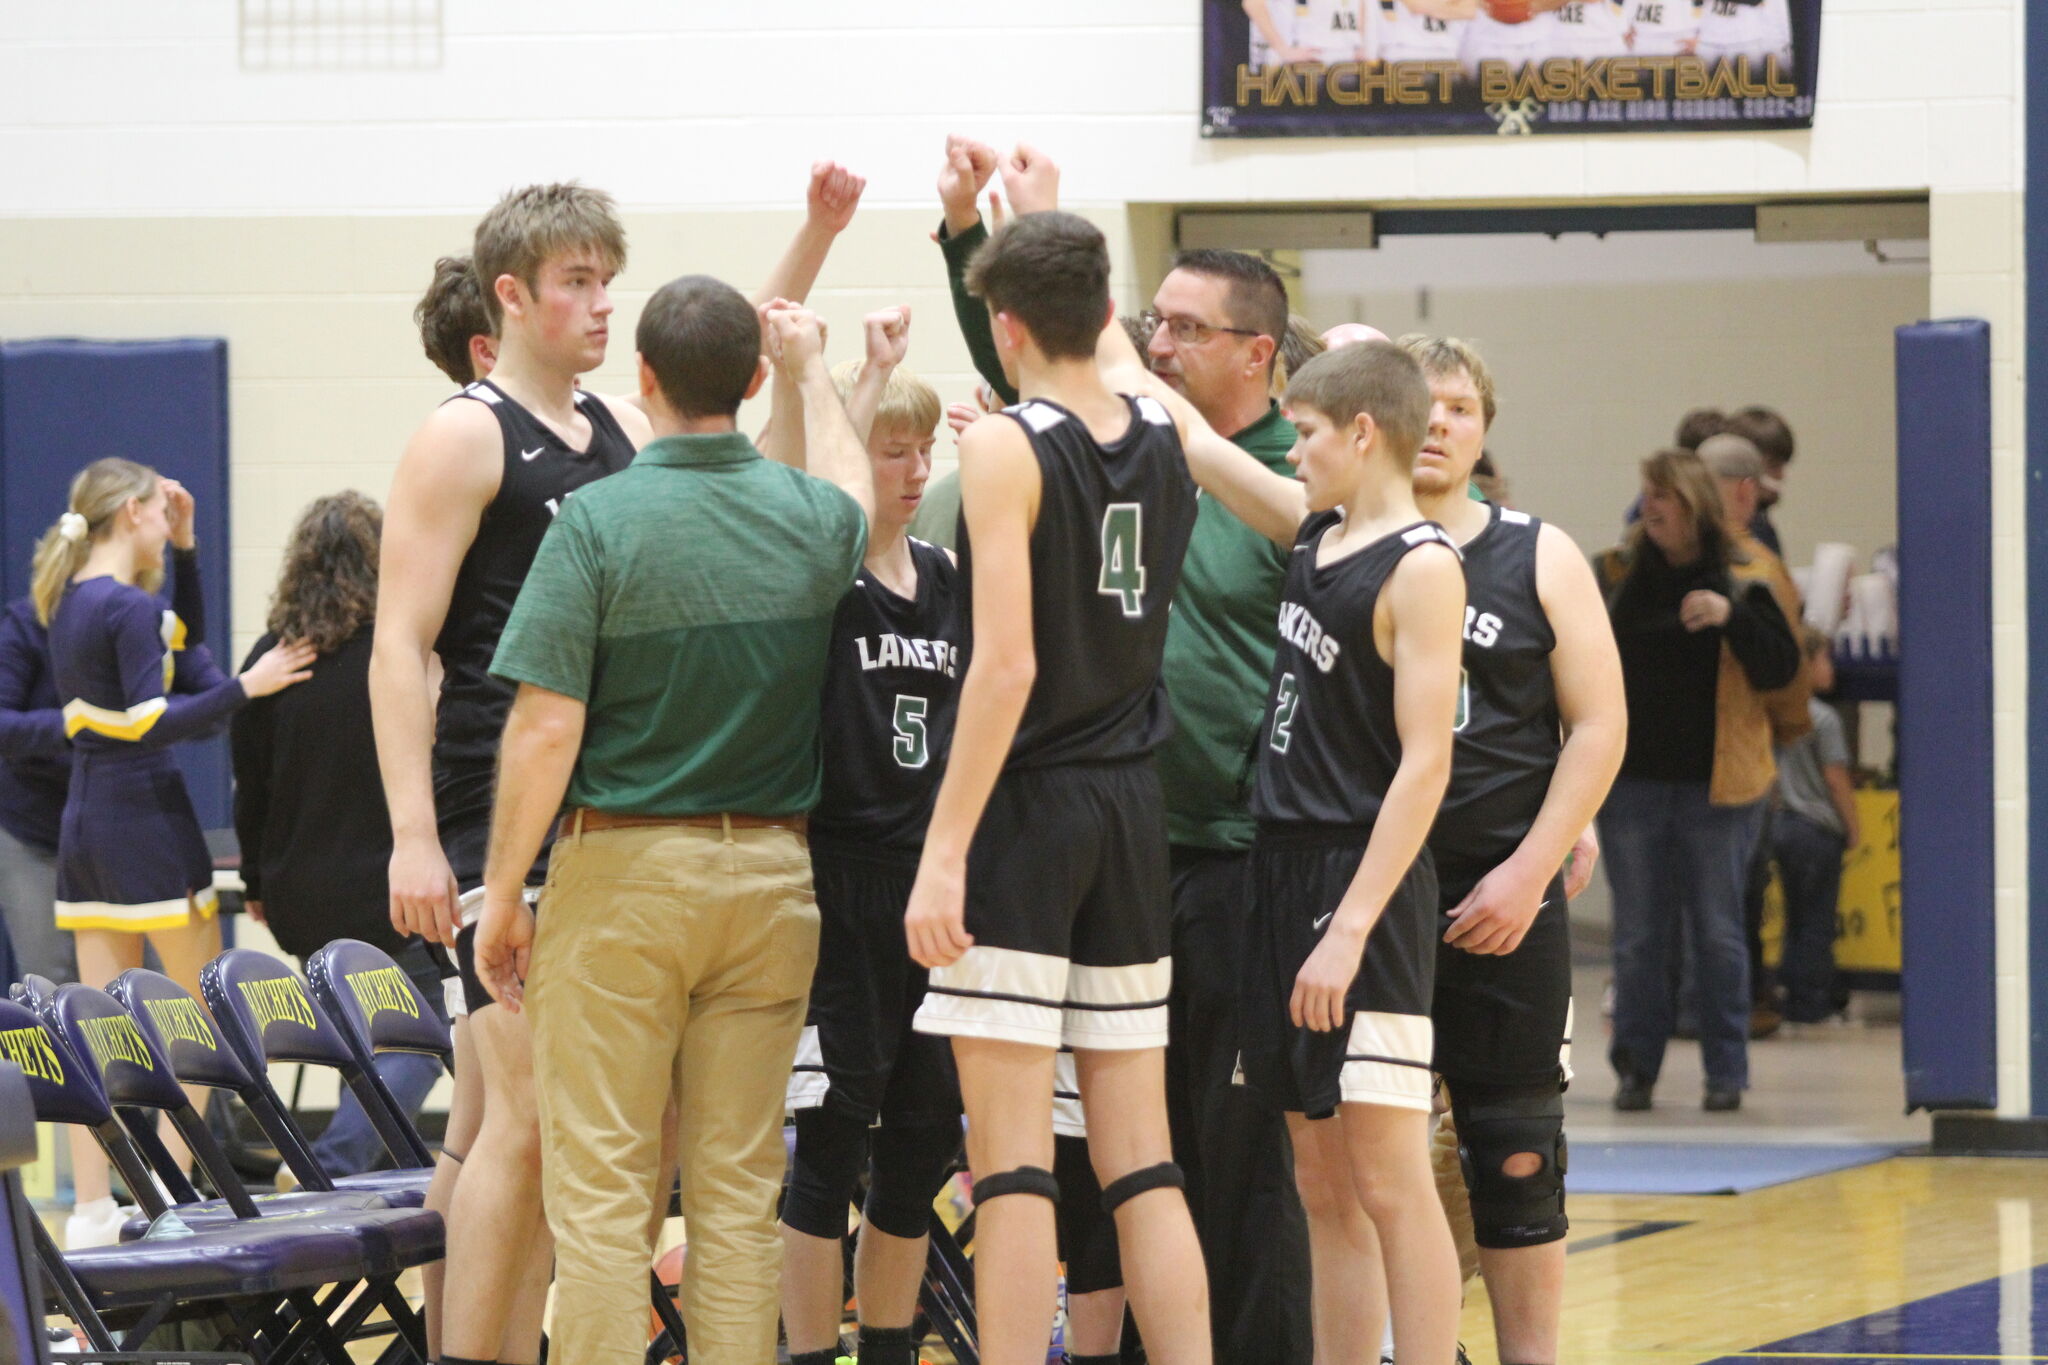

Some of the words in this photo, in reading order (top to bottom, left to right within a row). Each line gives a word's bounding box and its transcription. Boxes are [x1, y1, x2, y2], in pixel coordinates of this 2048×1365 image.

[1236, 60, 1461, 106] HATCHET
[1481, 54, 1797, 102] BASKETBALL
[1097, 503, 1146, 618] 4
[893, 694, 929, 769] 5
[1270, 672, 1299, 754] 2
[0, 1025, 65, 1086] HETS
